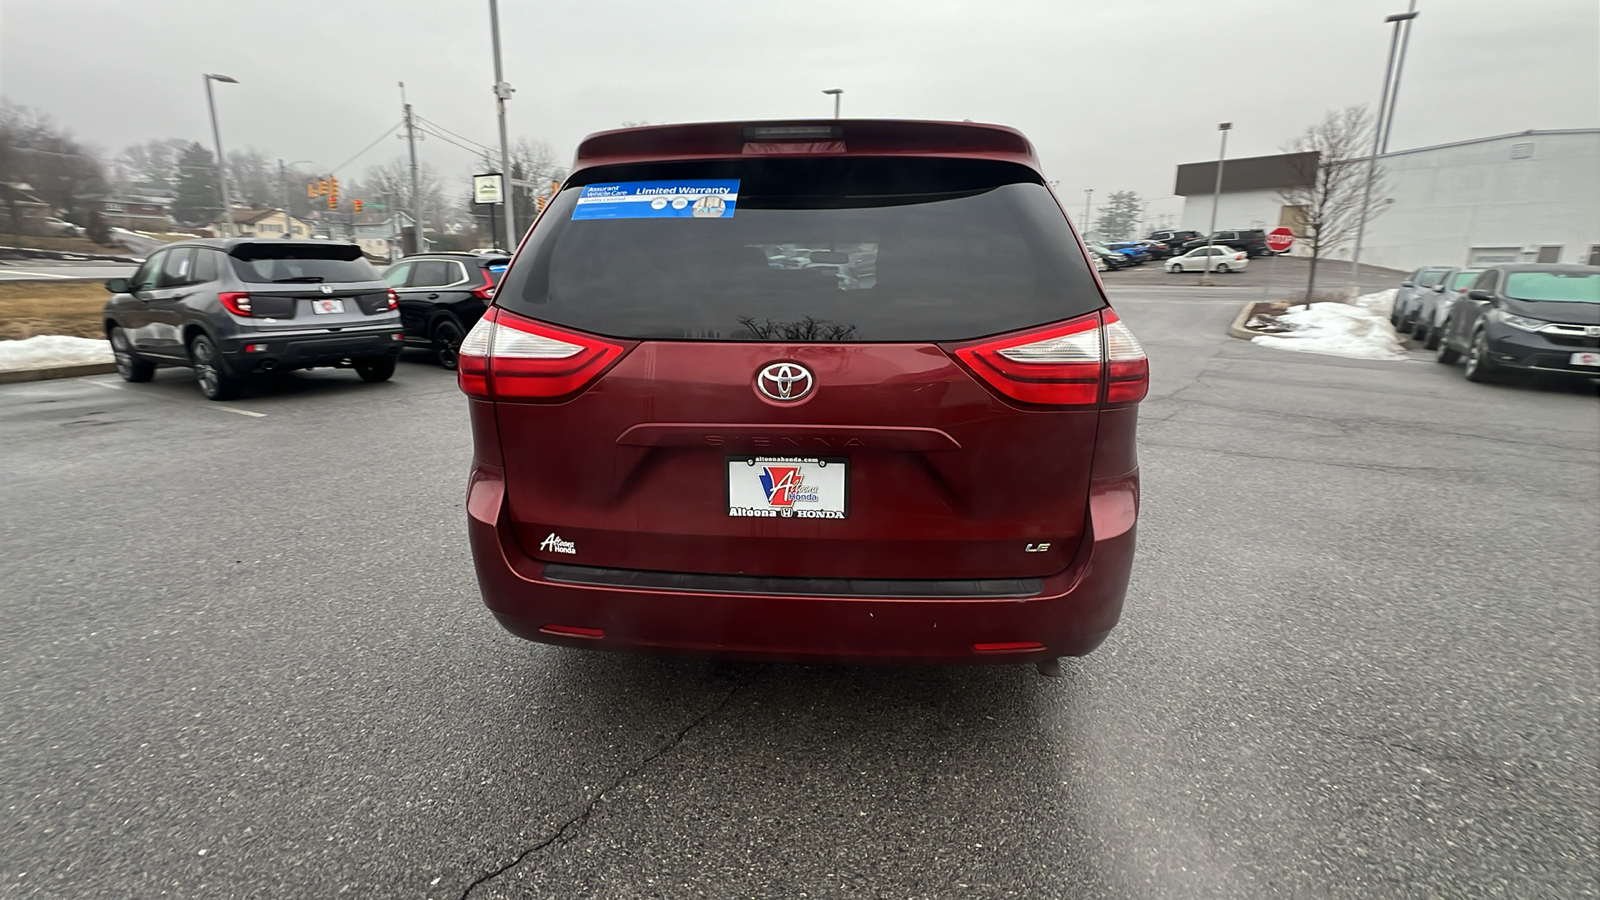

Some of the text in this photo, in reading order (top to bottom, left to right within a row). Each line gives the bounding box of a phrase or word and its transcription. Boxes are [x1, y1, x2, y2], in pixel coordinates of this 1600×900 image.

[635, 186, 731, 195] Limited Warranty
[1267, 234, 1294, 244] STOP
[788, 493, 818, 501] Honda
[729, 507, 777, 517] Altoona
[797, 510, 845, 519] HONDA
[554, 545, 576, 554] Honda
[1025, 543, 1051, 552] LE
